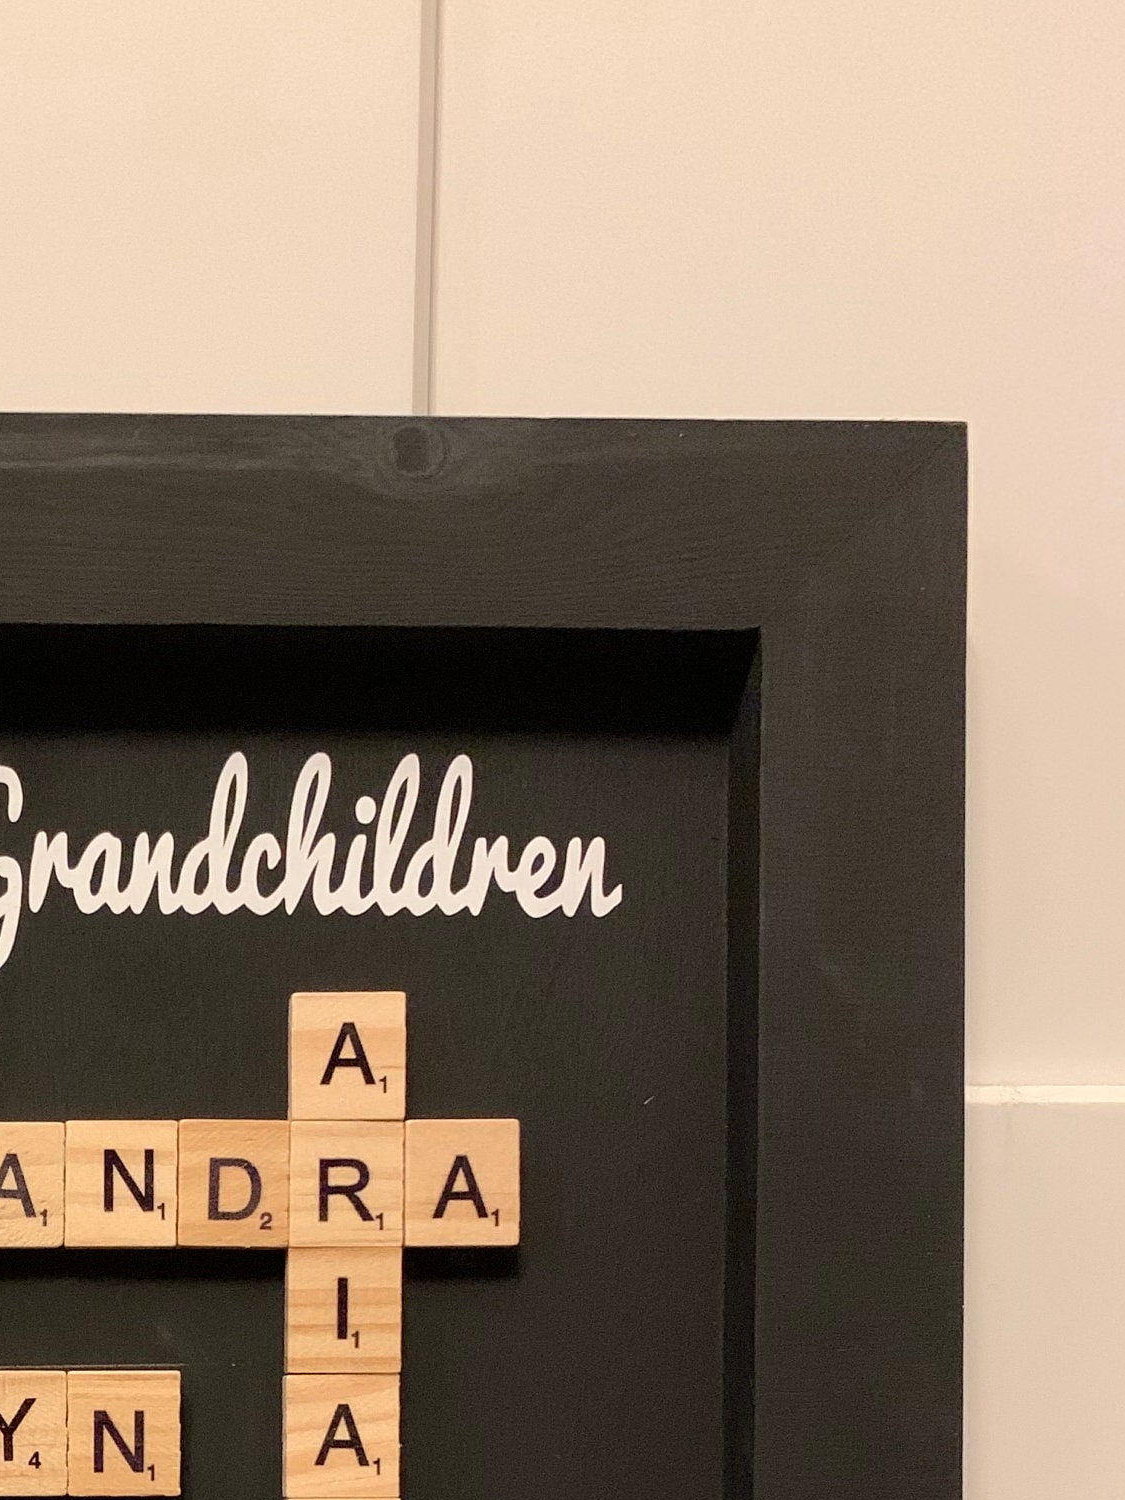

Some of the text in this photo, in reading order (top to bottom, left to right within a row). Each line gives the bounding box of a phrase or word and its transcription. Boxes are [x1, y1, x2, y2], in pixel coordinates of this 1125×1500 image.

[377, 1075, 388, 1094] 1
[38, 1208, 49, 1227] 1
[155, 1202, 166, 1221] 1
[258, 1211, 274, 1231] 2
[489, 1208, 501, 1227] 1
[374, 1212, 385, 1231] 1
[350, 1330, 361, 1349] 1
[27, 1451, 43, 1470] 4
[371, 1457, 382, 1476] 1
[145, 1464, 156, 1482] 1
